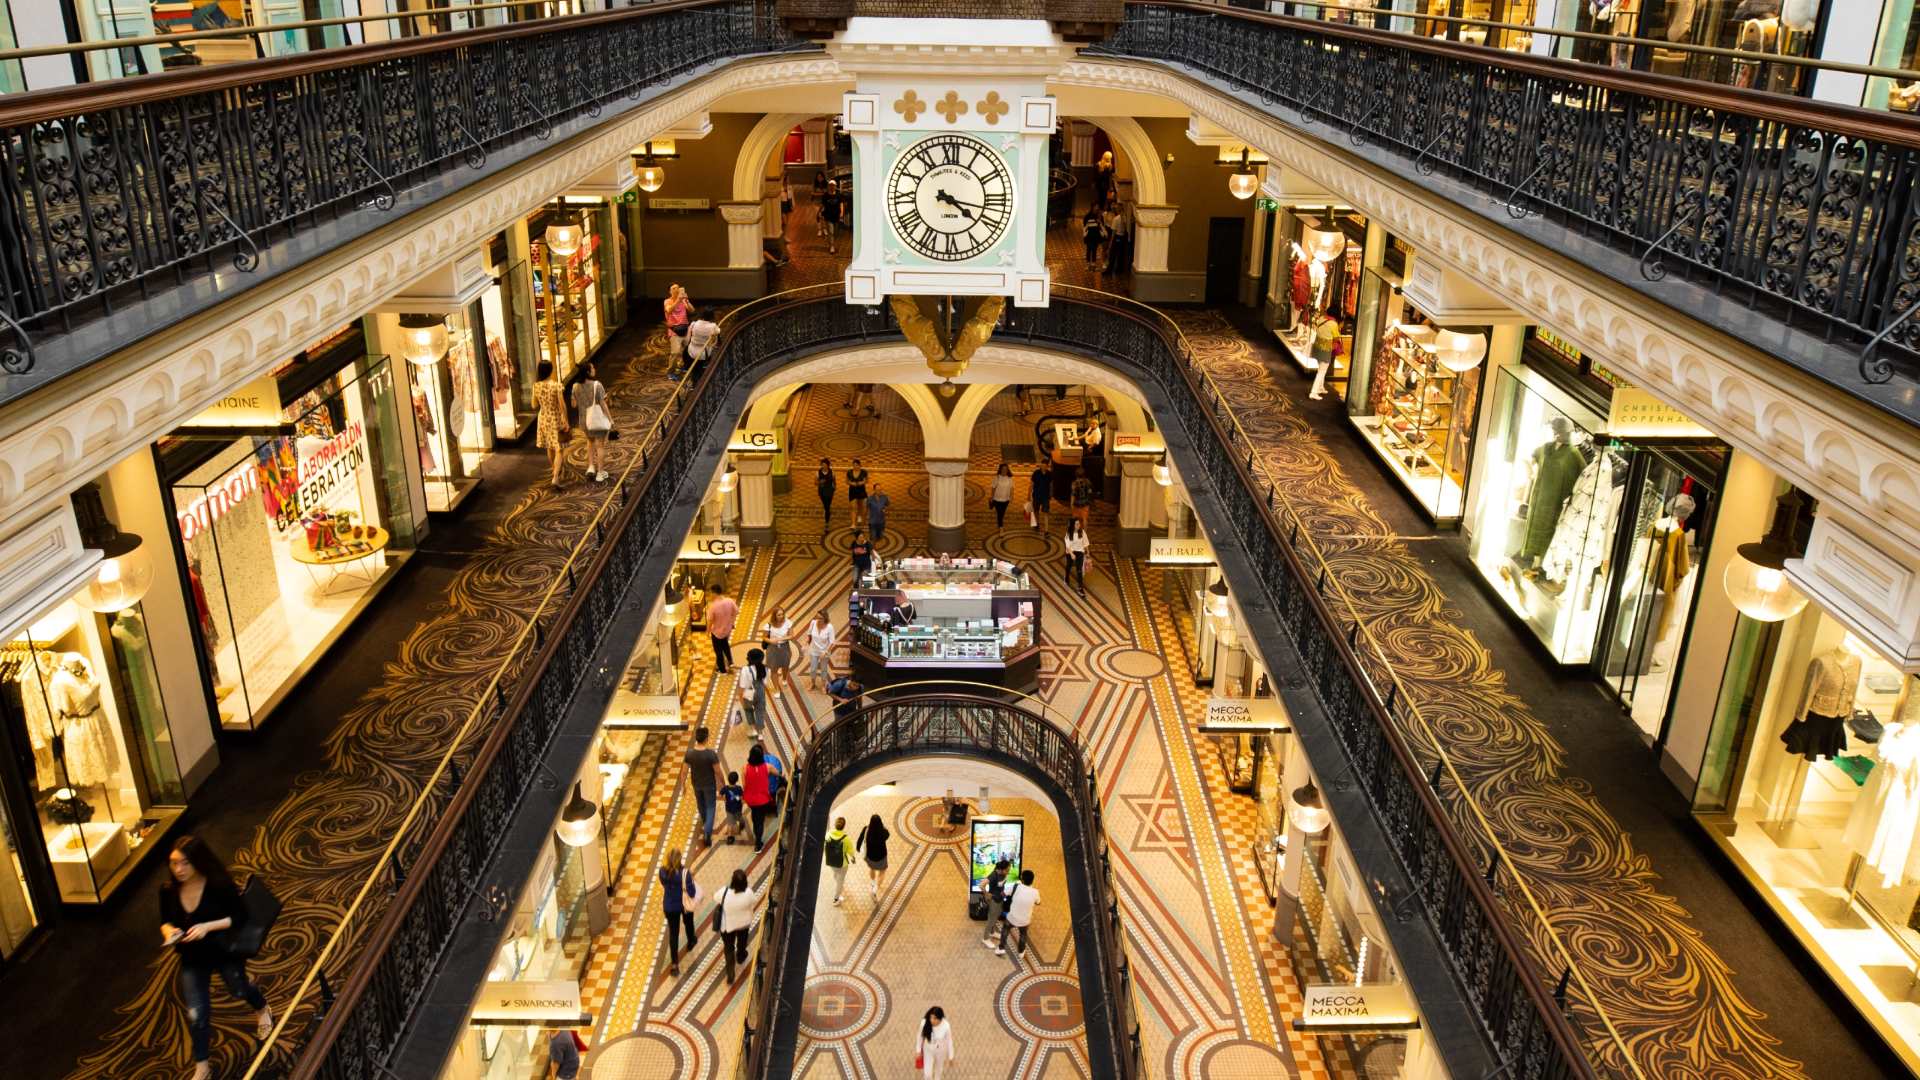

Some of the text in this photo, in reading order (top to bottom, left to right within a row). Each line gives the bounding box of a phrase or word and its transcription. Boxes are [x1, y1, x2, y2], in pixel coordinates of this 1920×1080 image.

[942, 143, 960, 164] XII
[742, 433, 774, 446] UGG
[276, 442, 364, 532] CELEBRATION
[697, 539, 736, 556] UGG
[1211, 706, 1250, 715] MECCA
[514, 1000, 573, 1008] SWAROVSKI
[1312, 996, 1366, 1006] MECCA
[1311, 1007, 1369, 1017] MAXIMA
